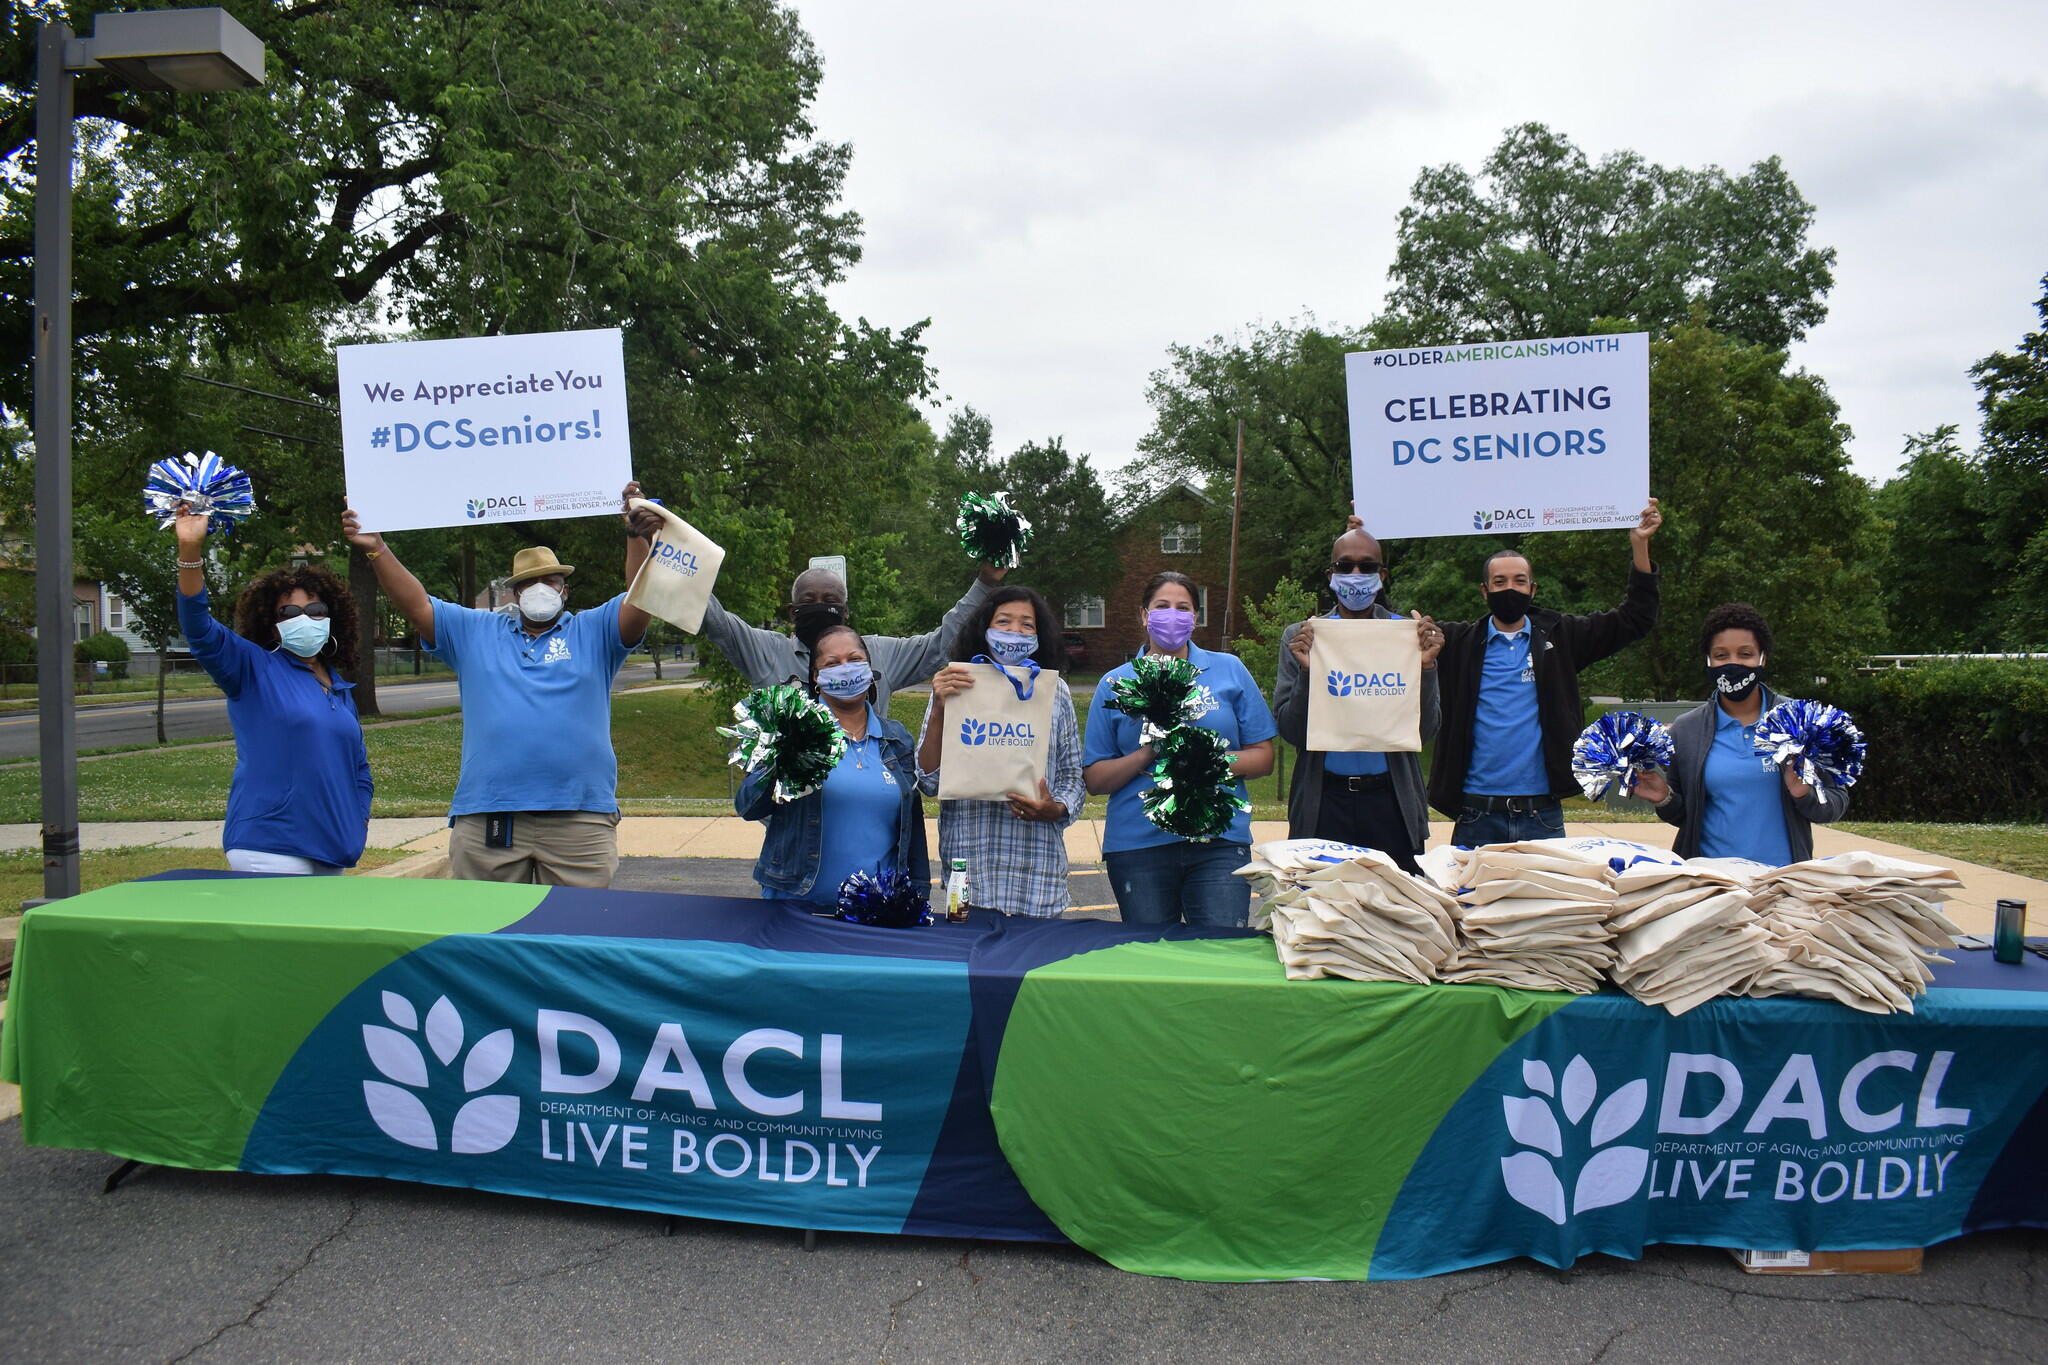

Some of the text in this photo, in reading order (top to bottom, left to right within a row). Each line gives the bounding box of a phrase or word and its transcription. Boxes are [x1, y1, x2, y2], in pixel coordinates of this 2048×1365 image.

[1373, 338, 1619, 368] #OLDERAMERICANSMONTH
[363, 382, 405, 403] We
[1384, 386, 1611, 423] CELEBRATING
[370, 409, 602, 453] #DCSeniors!
[1392, 428, 1607, 466] DC SENIORS
[487, 496, 527, 508] DACL
[572, 501, 601, 510] BOWSER,
[487, 508, 527, 518] LIVE BOLDLY
[1494, 508, 1535, 520] DACL
[1582, 516, 1614, 524] BOWSER,
[1615, 514, 1640, 522] MAYOR
[656, 556, 697, 577] LIVE BOLDLY
[661, 544, 698, 570] DACL
[1349, 586, 1372, 596] DACL
[841, 674, 864, 688] DACL
[1354, 672, 1406, 688] DACL
[1717, 672, 1756, 693] Peace
[1354, 688, 1406, 696] LIVE BOLDLY
[989, 722, 1035, 738] DACL
[988, 738, 1034, 746] LIVE BOLDLY
[537, 1008, 883, 1121] DACL
[1657, 1050, 1971, 1140] DACL
[540, 1101, 883, 1140] DEPARTMENT OF AGING AND COMMUNITY LIVING
[541, 1118, 882, 1188] LIVE BOLDLY
[1654, 1142, 1743, 1155] DEPARTMENT
[1746, 1142, 1767, 1153] OF
[1769, 1143, 1819, 1160] AGING
[1822, 1143, 1846, 1158] AND
[1849, 1137, 1927, 1154] COMMUNITY
[1647, 1151, 1960, 1204] LIVE BOLDLY
